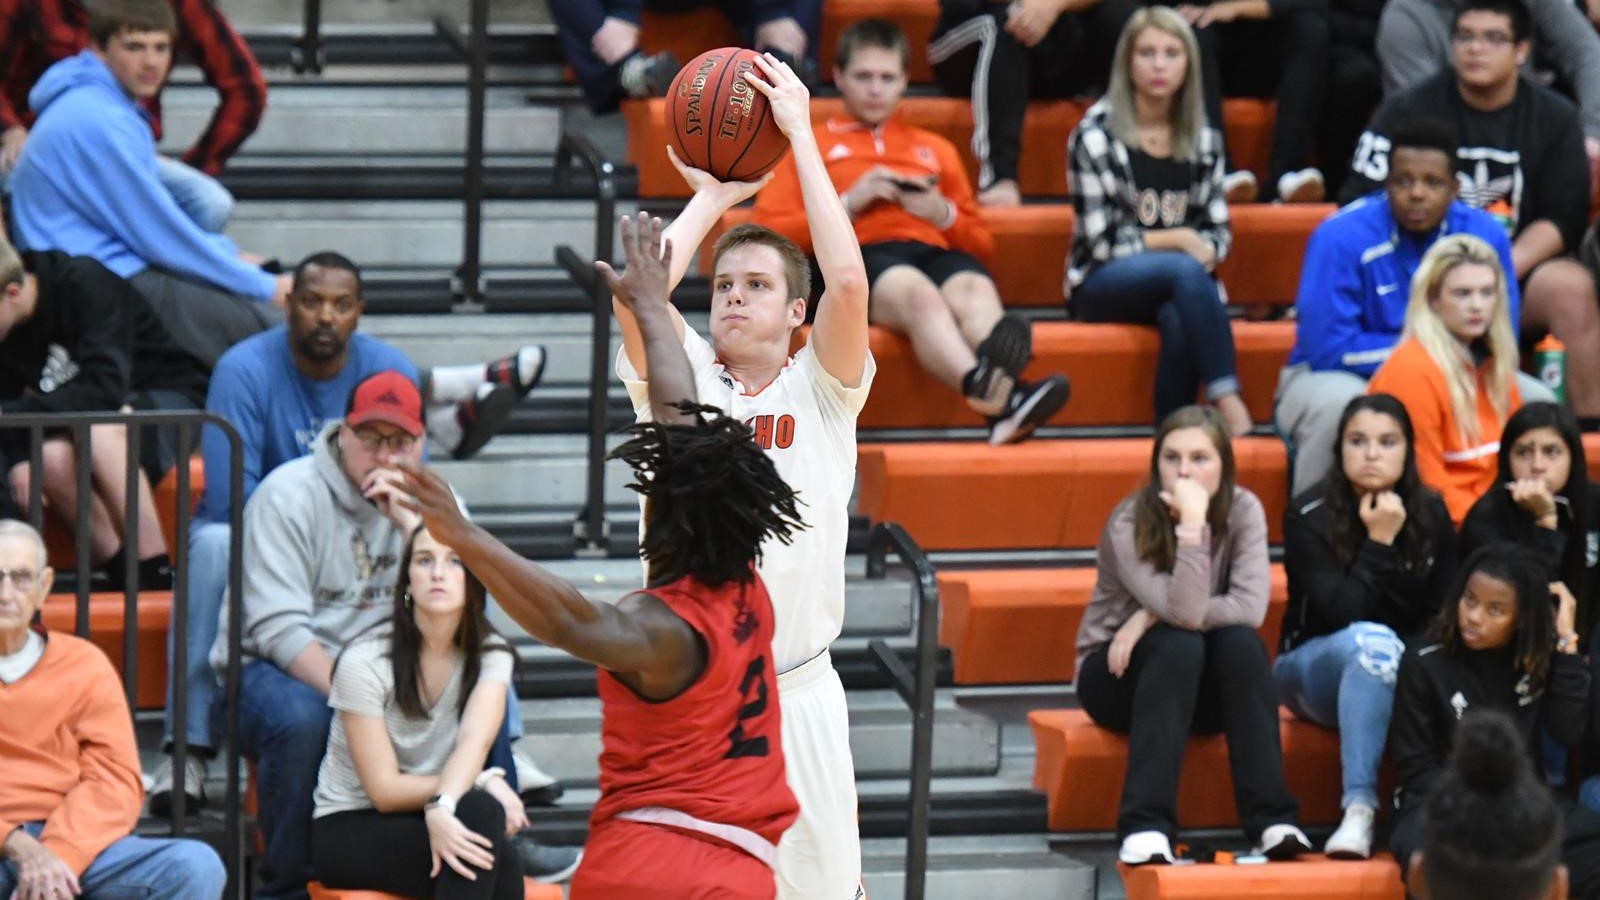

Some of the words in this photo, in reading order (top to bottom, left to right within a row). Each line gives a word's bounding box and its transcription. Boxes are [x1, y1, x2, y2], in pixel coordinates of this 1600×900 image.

[686, 54, 723, 136] SPALDING
[744, 414, 796, 450] HO
[722, 654, 769, 760] 2
